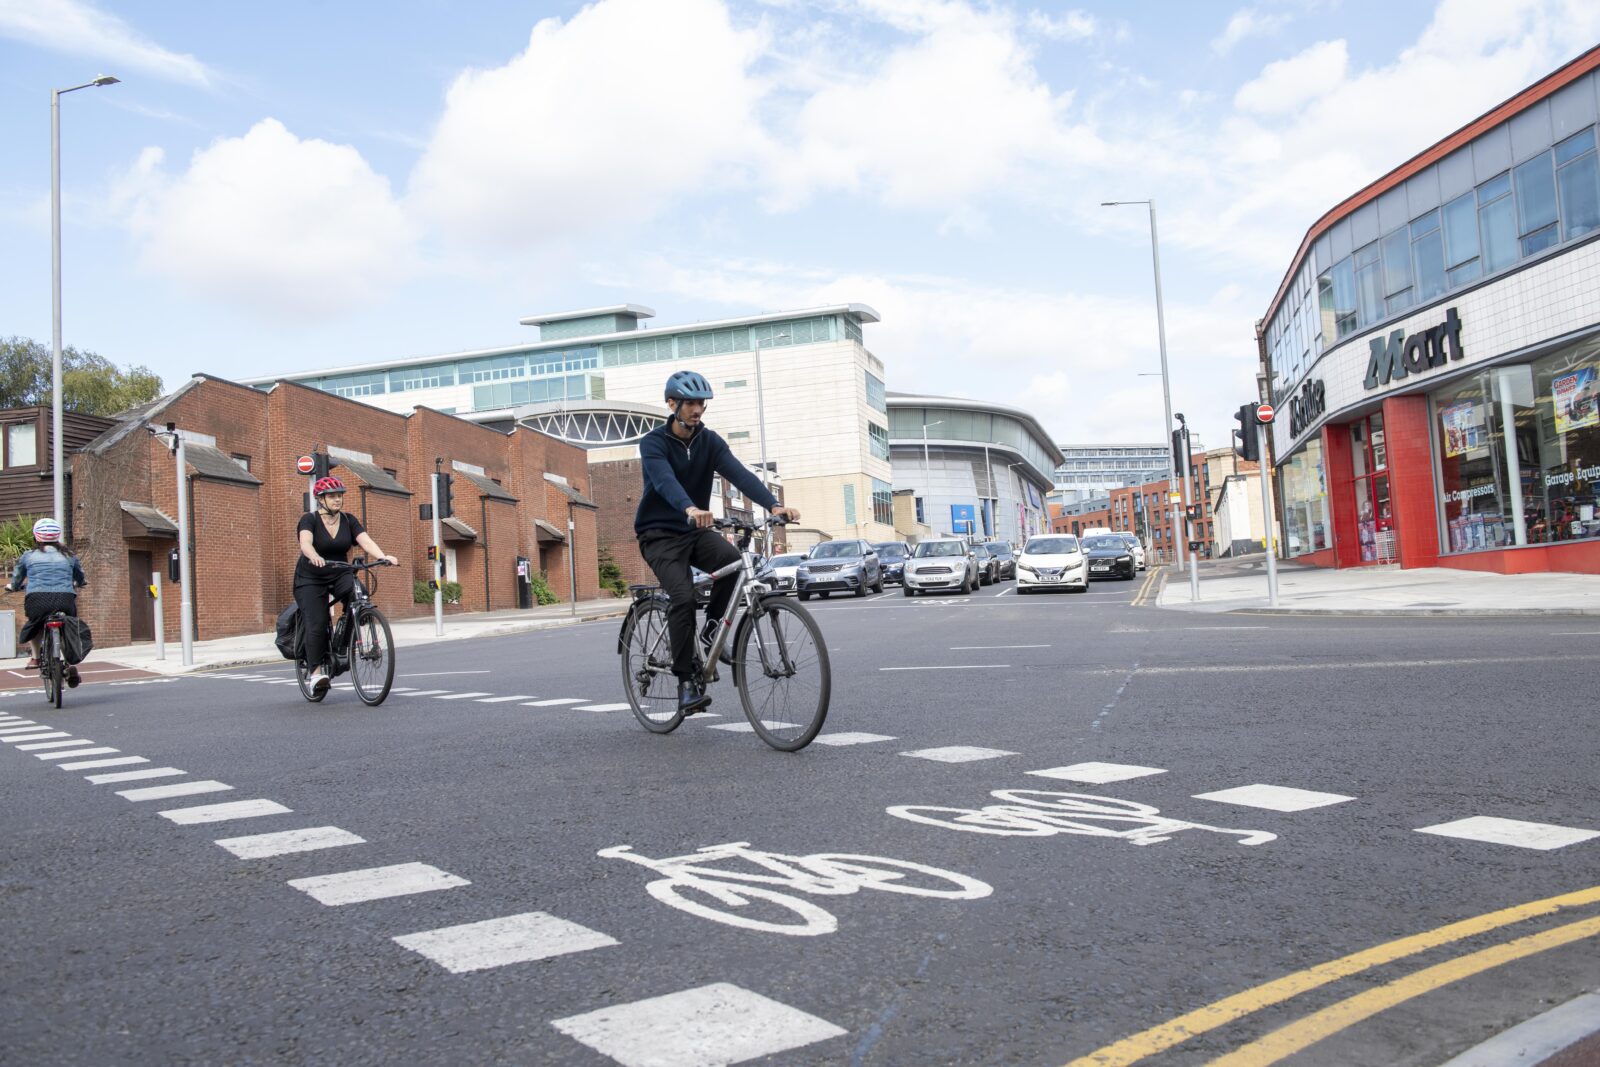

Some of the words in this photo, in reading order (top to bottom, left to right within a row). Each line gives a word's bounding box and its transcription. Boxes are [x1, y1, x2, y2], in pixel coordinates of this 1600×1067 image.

[1363, 306, 1464, 390] Mart
[1553, 375, 1578, 389] GARDEN
[1545, 472, 1574, 487] Garage
[1452, 484, 1494, 501] Compressors
